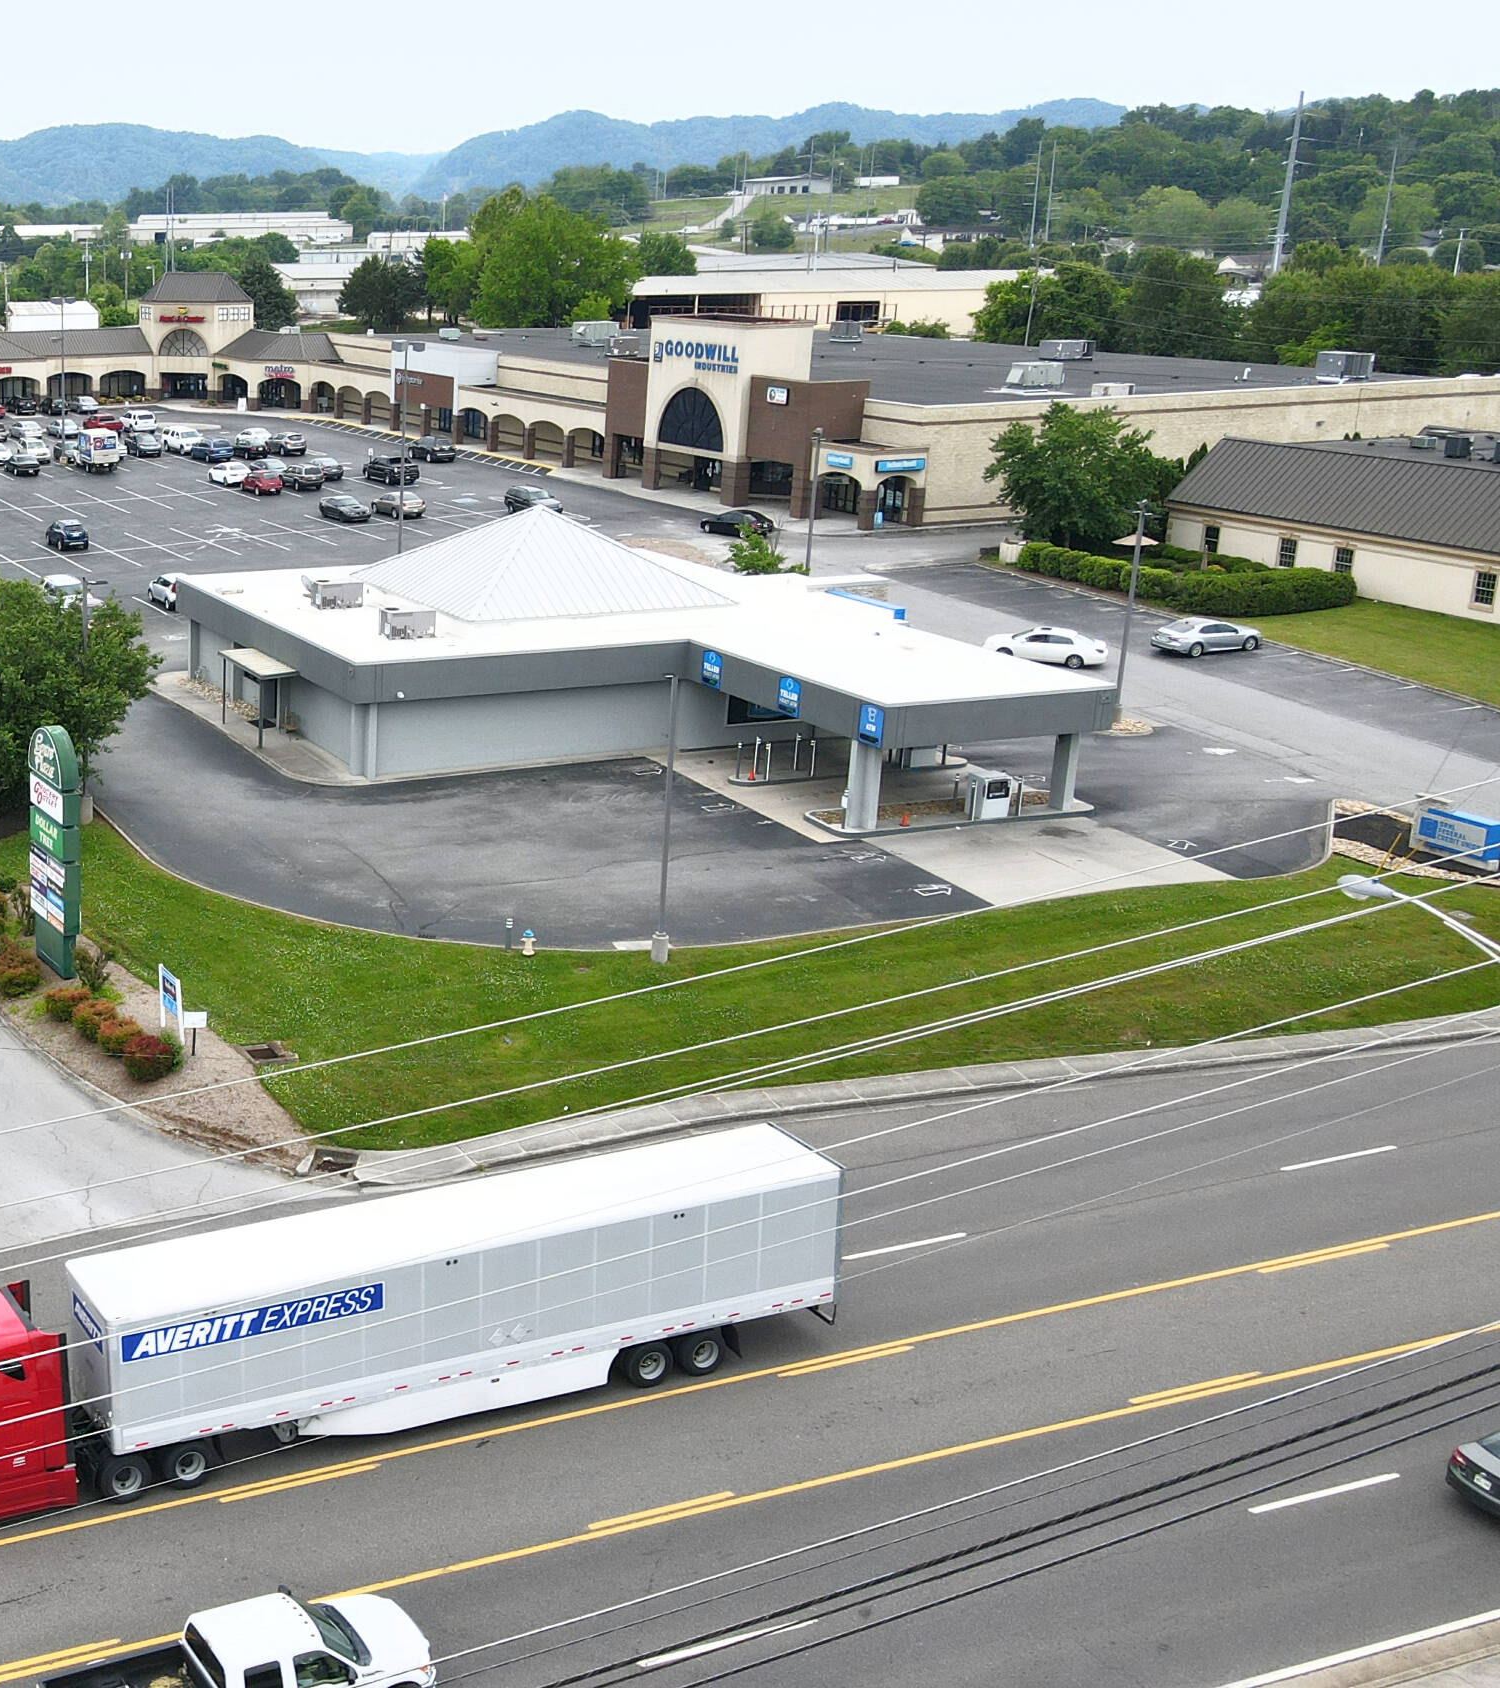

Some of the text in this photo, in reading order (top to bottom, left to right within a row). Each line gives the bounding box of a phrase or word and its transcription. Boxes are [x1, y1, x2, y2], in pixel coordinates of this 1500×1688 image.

[665, 340, 739, 363] GOODWILL
[35, 813, 58, 841] DOLLAR
[39, 830, 53, 851] TREE
[131, 1286, 376, 1359] AVERITT EXPRESS
